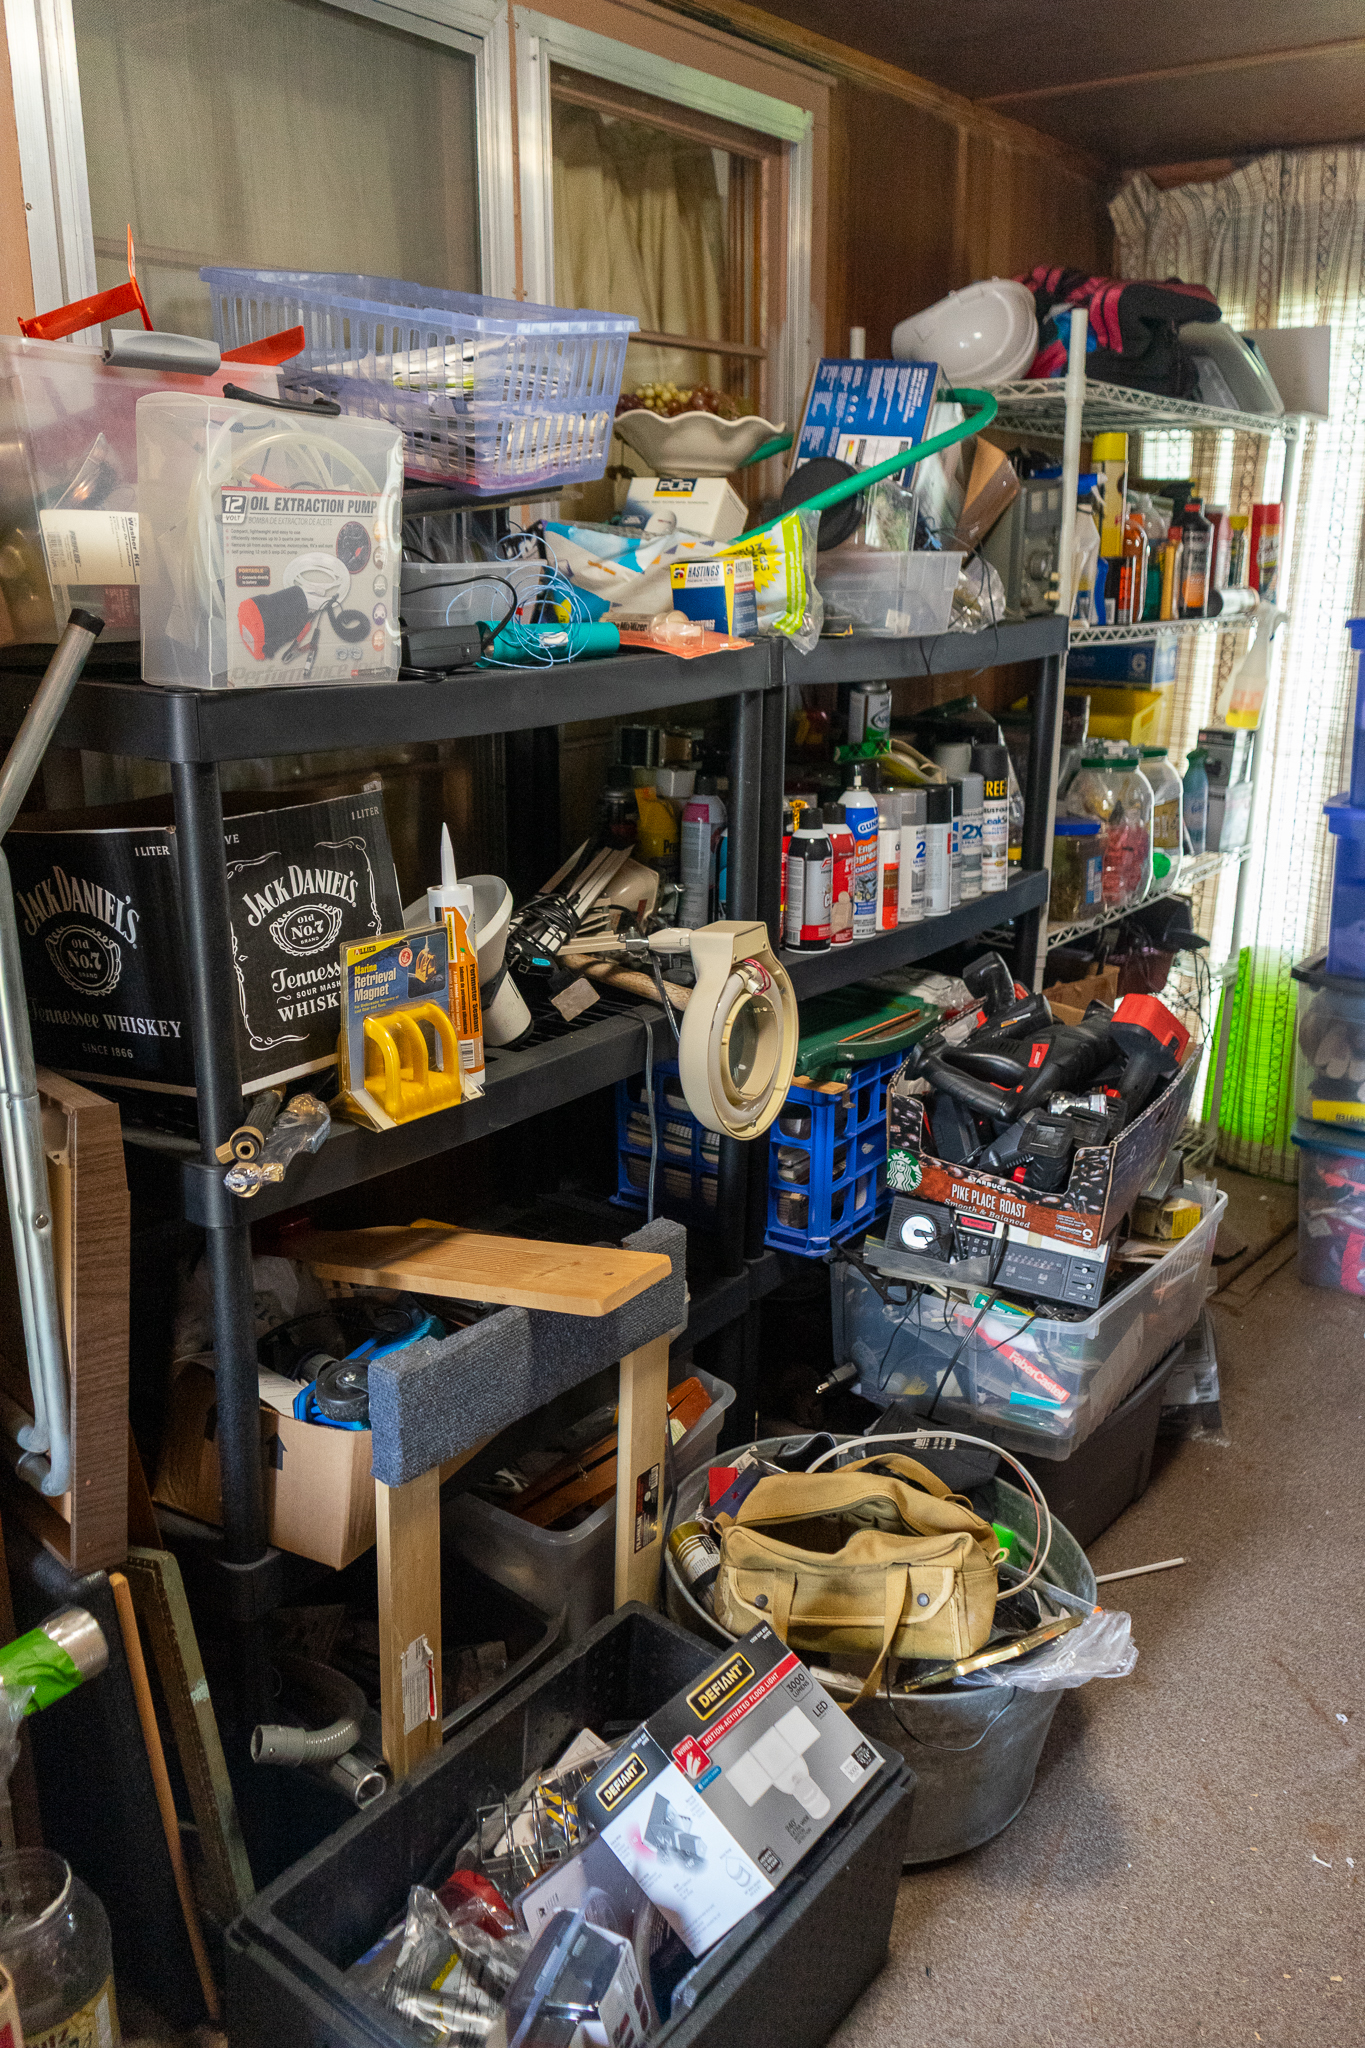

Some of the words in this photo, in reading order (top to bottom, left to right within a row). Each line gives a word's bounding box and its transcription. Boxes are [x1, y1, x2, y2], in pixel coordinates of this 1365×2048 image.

[224, 496, 244, 512] 12
[250, 496, 270, 510] OIL
[274, 497, 344, 513] EXTRACTION
[348, 500, 378, 514] PUMP
[128, 517, 137, 550] Washer
[687, 564, 720, 578] HASTINGS
[1132, 654, 1146, 672] 6
[351, 812, 355, 820] 1
[356, 806, 380, 819] LITER
[962, 824, 984, 840] 2X
[140, 846, 171, 856] LITER
[16, 878, 62, 936] JACK
[53, 865, 140, 944] DANIEL'S
[242, 876, 292, 927] JACK
[288, 865, 358, 904] DANIEL'S
[297, 914, 315, 924] Old
[290, 920, 324, 941] No.7
[71, 938, 90, 949] Old
[300, 936, 320, 945] BRAND
[67, 950, 102, 971] No.7
[354, 964, 378, 975] Marine
[271, 962, 341, 993] Tenness
[354, 967, 397, 989] Retrieval
[470, 963, 478, 1002] Perimeter
[296, 986, 318, 998] SOUR
[320, 980, 342, 992] MASH
[354, 983, 389, 1003] Magnet
[277, 992, 342, 1022] WHISK
[30, 998, 99, 1029] Tennessee
[102, 1013, 182, 1038] WHISKEY
[472, 1003, 480, 1033] Sealant
[82, 1042, 109, 1056] SINCE
[111, 1046, 134, 1059] 1866
[968, 1175, 1012, 1193] STARBUCKS
[952, 1183, 970, 1204] PIKE
[971, 1188, 996, 1210] PLACE
[999, 1198, 1027, 1218] ROAST
[944, 1198, 977, 1213] Smooth
[979, 1207, 987, 1216] &
[988, 1210, 1031, 1228] Balanced
[698, 1663, 743, 1708] DEFIANT
[786, 1673, 805, 1692] 3000
[793, 1680, 810, 1698] LUMENS
[702, 1701, 750, 1747] MOTION-ACTIVATED
[749, 1685, 766, 1704] FLOOD
[764, 1672, 779, 1688] LIGHT
[812, 1700, 828, 1718] LED
[676, 1740, 694, 1757] WIRED
[603, 1762, 638, 1802] DEFIANT
